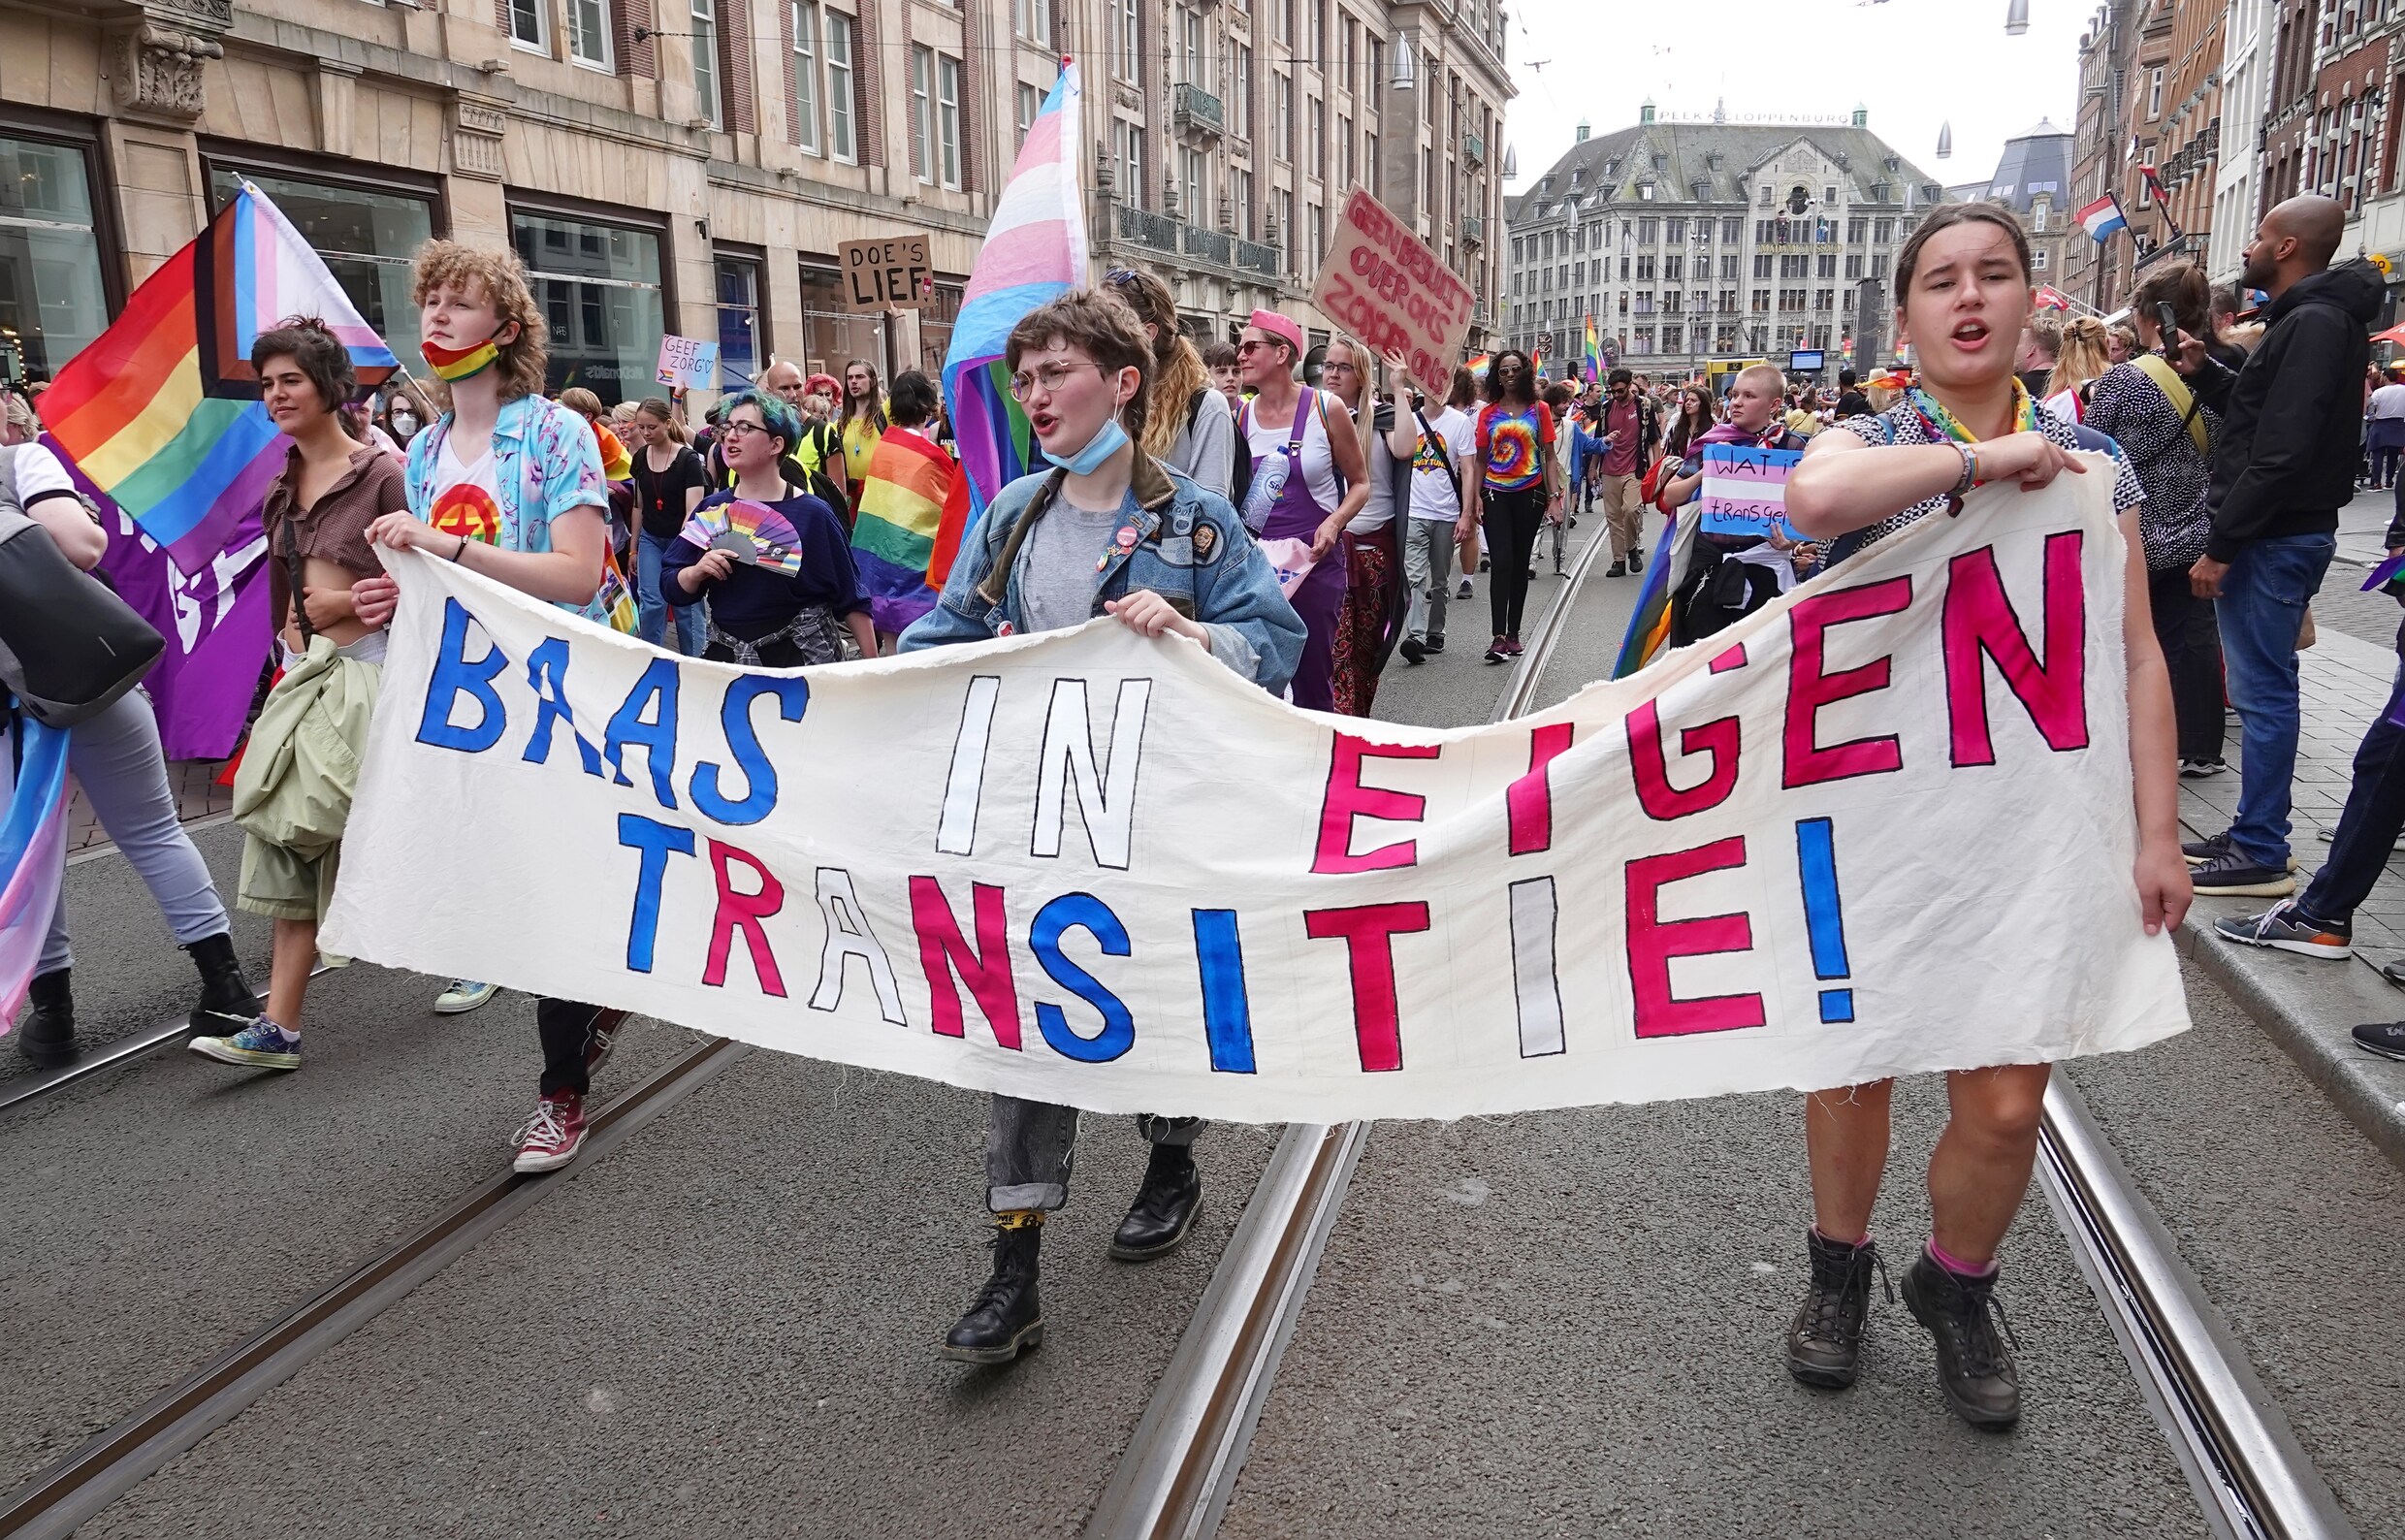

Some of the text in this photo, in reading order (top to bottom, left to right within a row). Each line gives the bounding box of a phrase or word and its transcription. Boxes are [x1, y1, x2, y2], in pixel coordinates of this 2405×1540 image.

[1659, 111, 1703, 121] PEEK
[1722, 112, 1849, 123] CLOPPENBURG
[850, 242, 923, 267] DOE'S
[851, 267, 926, 305] LIEF
[1350, 245, 1451, 345] OVER ONS
[1412, 347, 1449, 396] ONS
[1712, 449, 1772, 475] WAT
[415, 529, 2089, 876] BAAS IN EIGEN
[617, 813, 1856, 1075] TRANSITIE!
